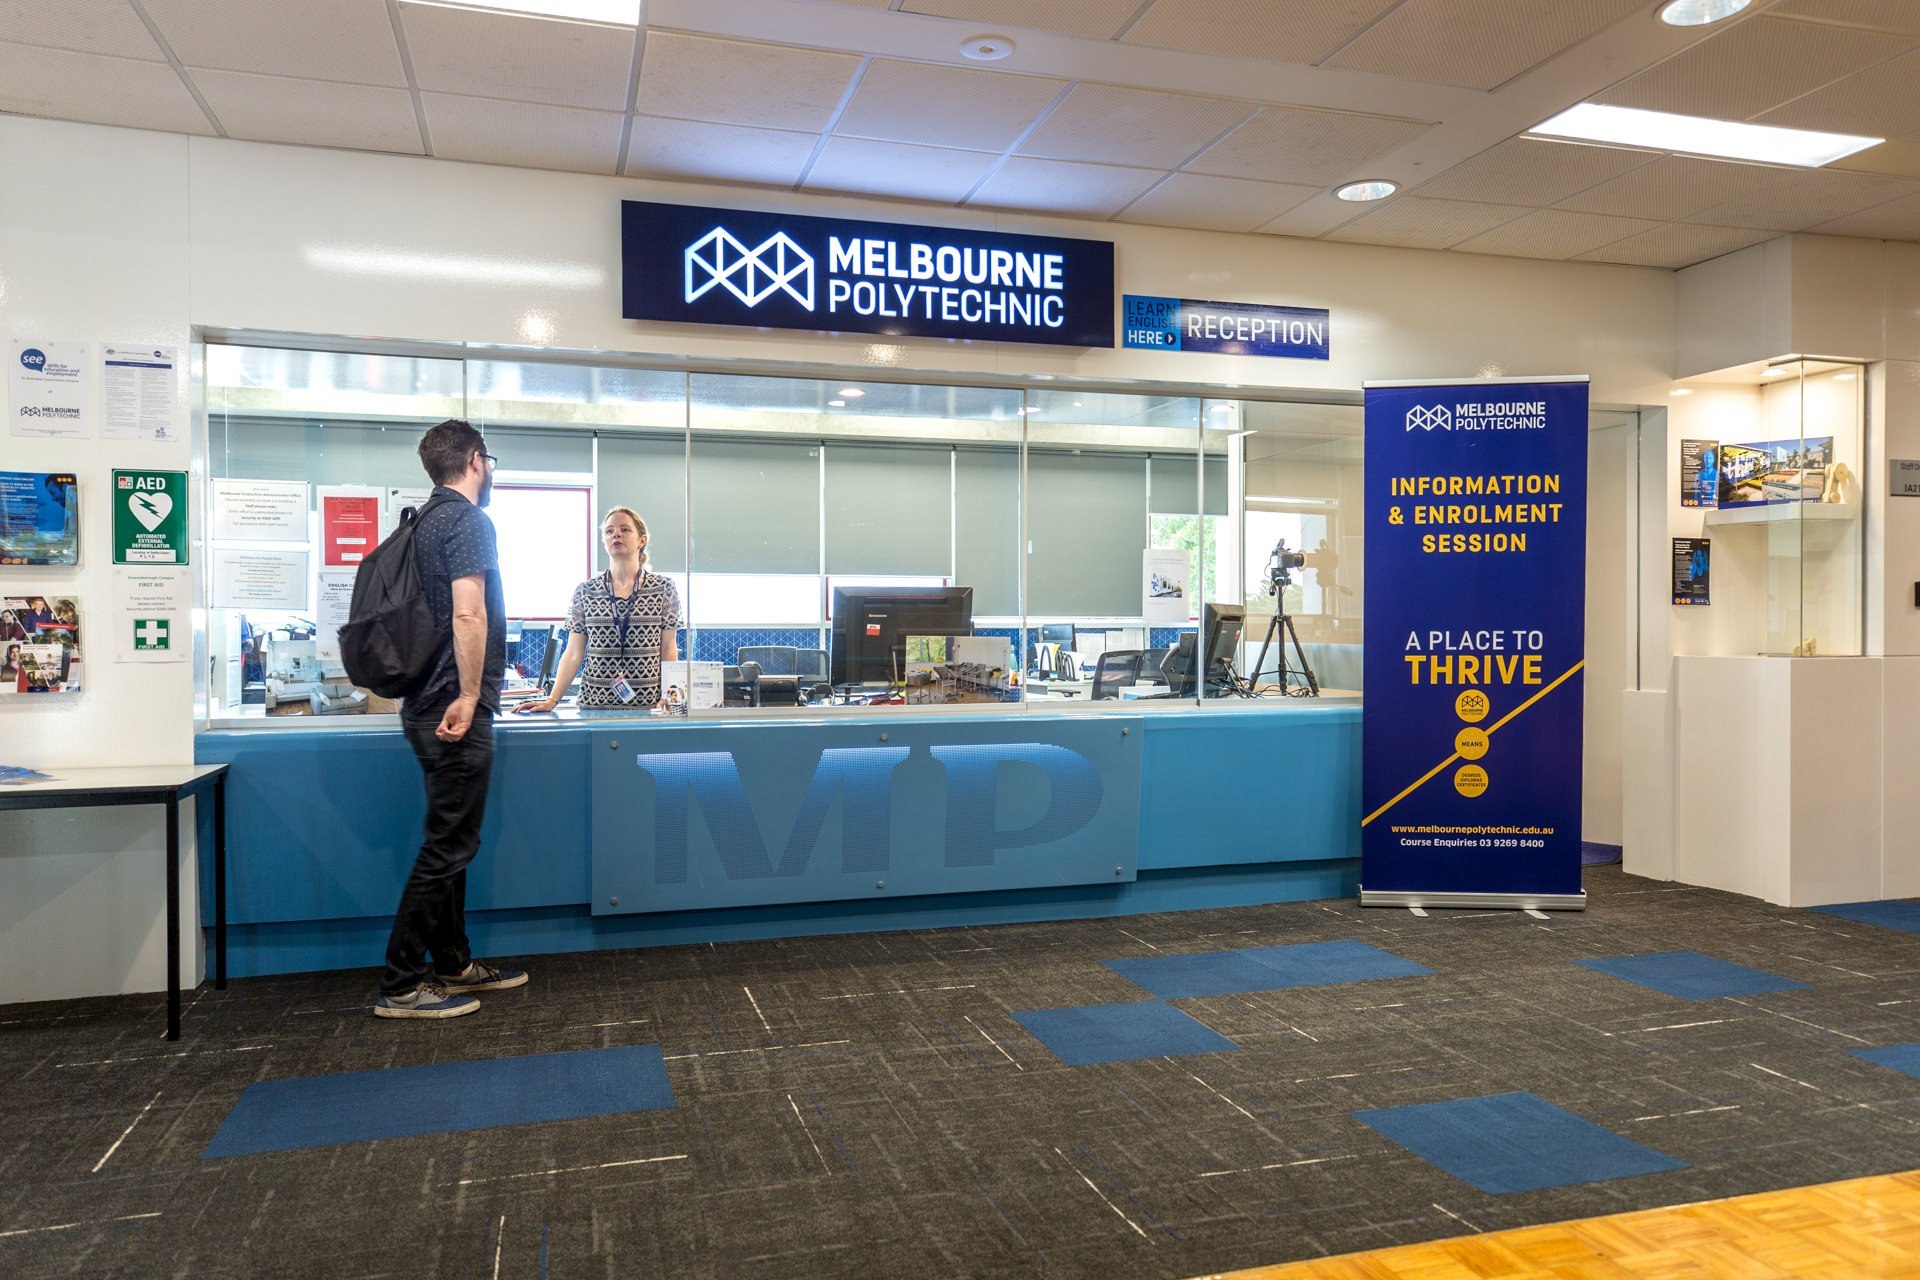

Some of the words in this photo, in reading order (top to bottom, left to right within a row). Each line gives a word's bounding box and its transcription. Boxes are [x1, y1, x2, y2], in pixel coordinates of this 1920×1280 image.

[828, 235, 1065, 290] MELBOURNE
[828, 279, 1065, 329] POLYTECHNIC
[1128, 300, 1176, 317] LEARN
[1128, 316, 1177, 330] ENGLISH
[1187, 313, 1323, 346] RECEPTION
[1128, 329, 1163, 345] HERE
[22, 355, 44, 364] see
[42, 406, 80, 414] MELBOURNE
[42, 412, 80, 420] POLYTECHNIC
[1455, 401, 1546, 417] MELBOURNE
[1455, 416, 1546, 431] POLYTECHNIC
[135, 476, 166, 490] AED
[1391, 474, 1560, 496] INFORMATION
[1388, 506, 1404, 525] &
[1414, 503, 1563, 525] ENROLMENT
[1422, 533, 1527, 553] SESSION
[1405, 630, 1422, 651] A
[1429, 630, 1505, 651] PLACE
[1512, 629, 1544, 650] TO
[1404, 654, 1543, 685] THRIVE
[637, 742, 1104, 886] MP
[1391, 824, 1554, 836] www.melbournepolytechnic.edu.au
[1400, 838, 1432, 847] Course
[1433, 838, 1478, 848] Enquiries
[1479, 839, 1492, 847] 03
[1494, 839, 1518, 848] 9269
[1519, 839, 1545, 848] 8400
